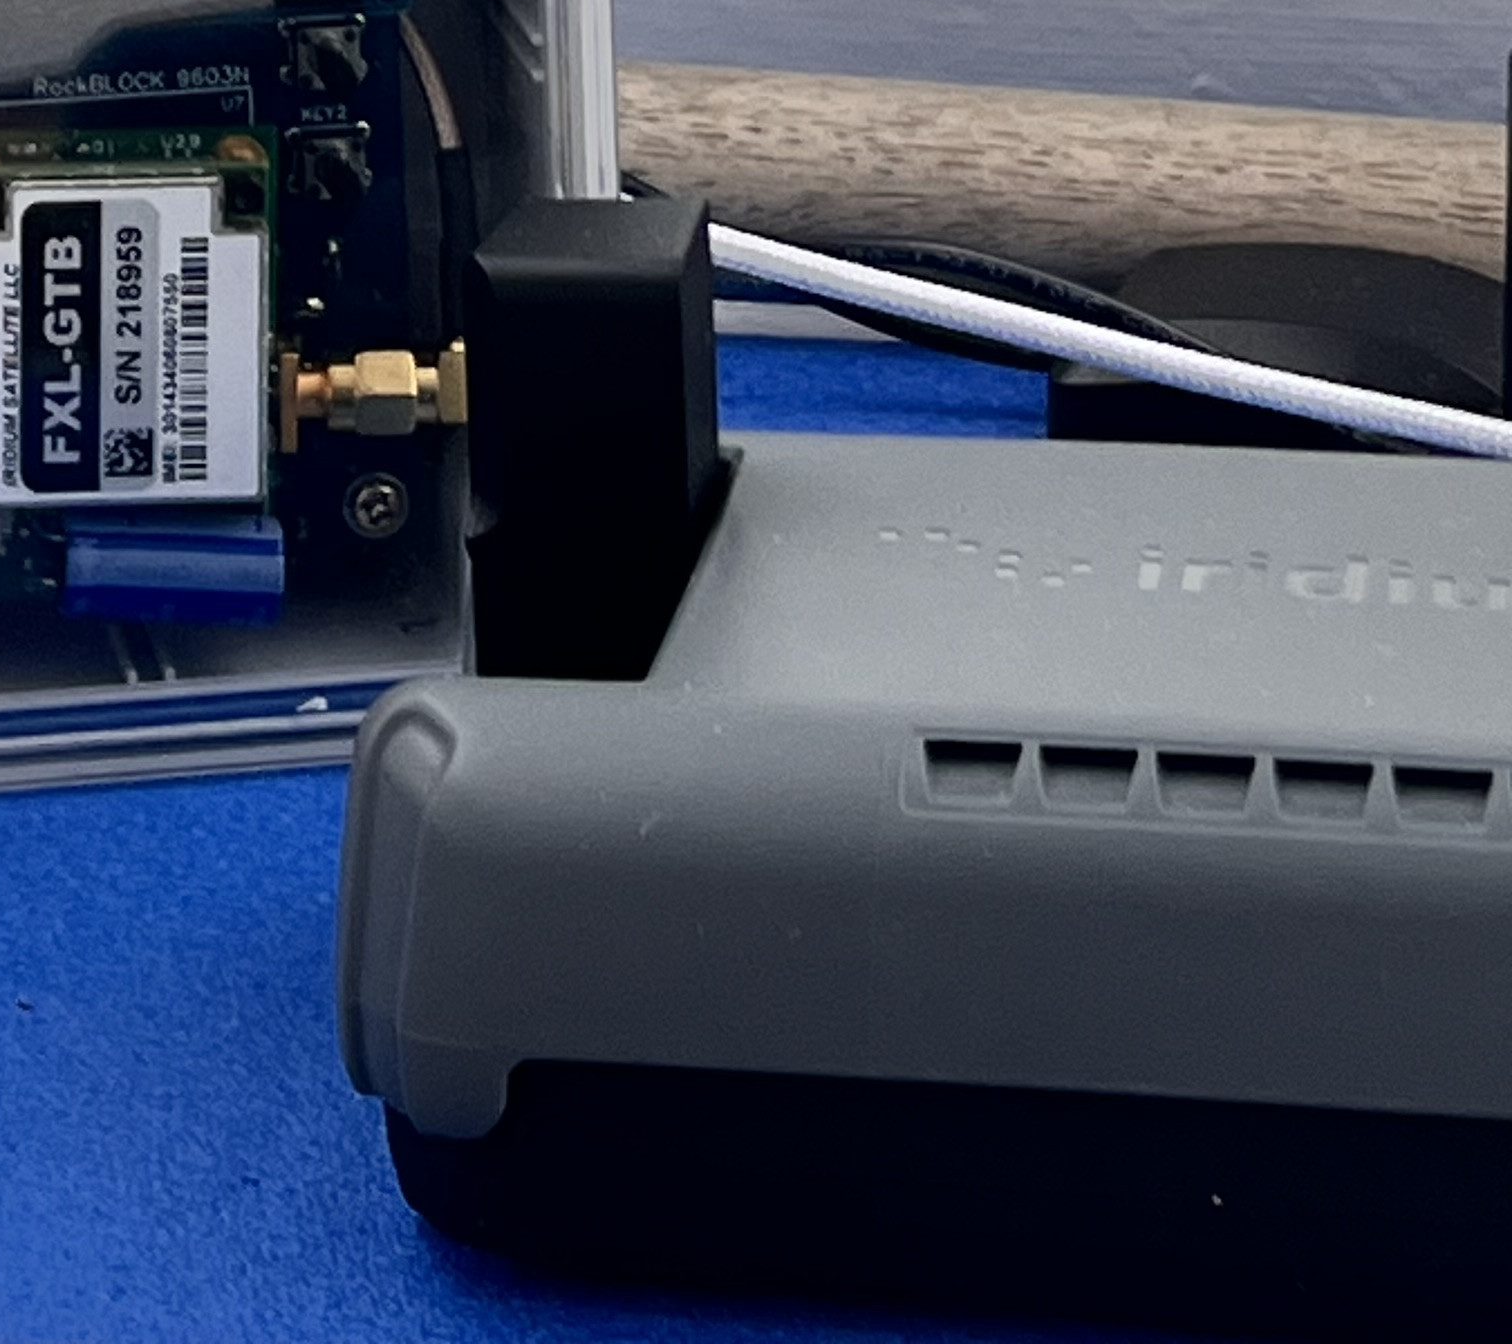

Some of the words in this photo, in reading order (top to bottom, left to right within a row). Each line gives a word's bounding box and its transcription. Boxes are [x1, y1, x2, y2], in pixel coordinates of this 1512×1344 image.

[33, 69, 165, 99] RockBLOCK
[3, 263, 20, 300] LLC
[115, 226, 143, 338] 218959
[2, 305, 20, 409] SATELLITE
[42, 234, 82, 464] FXL-GTB
[114, 349, 143, 405] S/N
[2, 413, 20, 488] IRIDIUM
